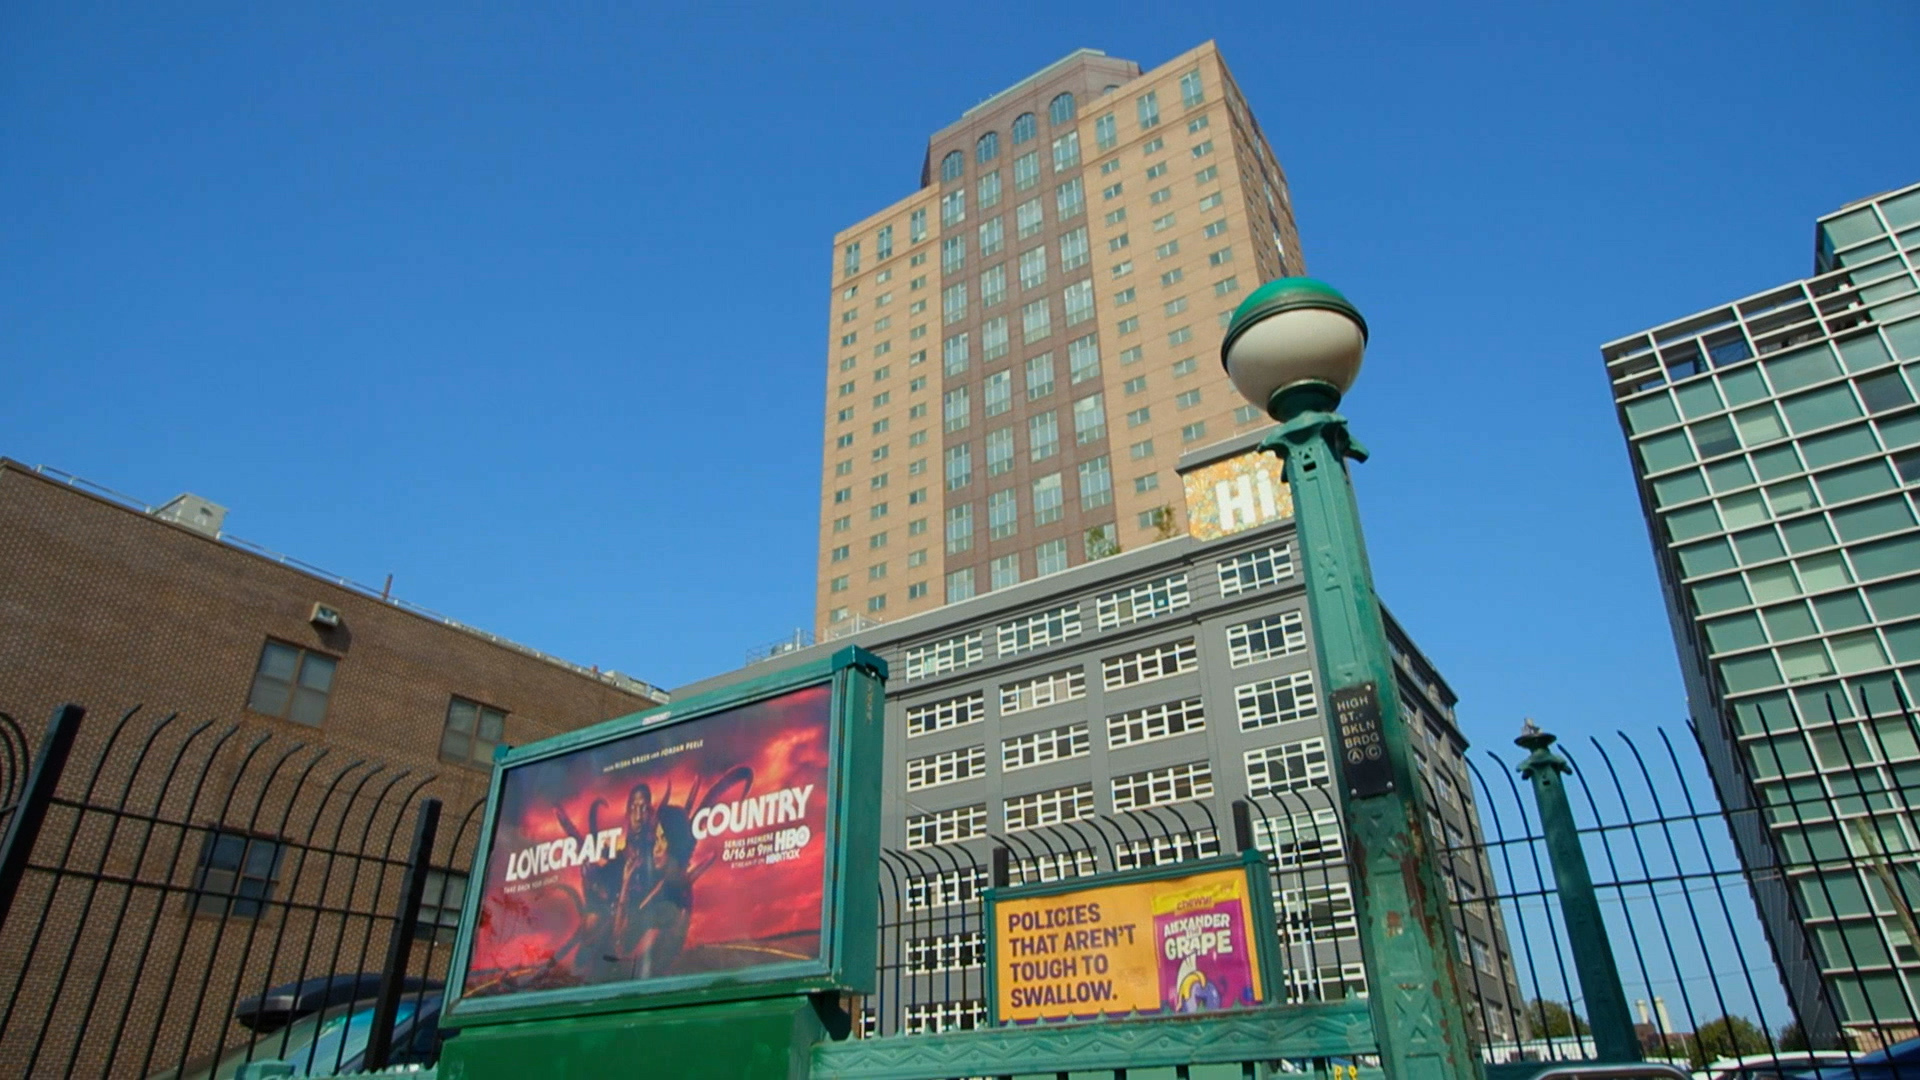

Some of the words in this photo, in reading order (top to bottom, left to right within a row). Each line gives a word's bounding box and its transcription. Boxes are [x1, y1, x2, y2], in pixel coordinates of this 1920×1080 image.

[1215, 469, 1277, 531] Hi
[1337, 695, 1369, 712] HIGH
[1342, 719, 1375, 736] BKLN
[1344, 731, 1380, 749] BRDG
[691, 784, 814, 840] COUNTRY
[774, 825, 810, 852] HBO
[505, 827, 623, 882] LOVECRAFT
[722, 847, 746, 862] 8/16
[746, 847, 756, 859] AT
[1008, 903, 1101, 933] POLICIES
[1009, 933, 1059, 957] THAT
[1064, 923, 1136, 952] AREN'T
[1164, 929, 1234, 961] GRAPE
[1009, 957, 1078, 983] TOUGH
[1081, 953, 1109, 976] TO
[1010, 979, 1118, 1008] SWALLOW.
